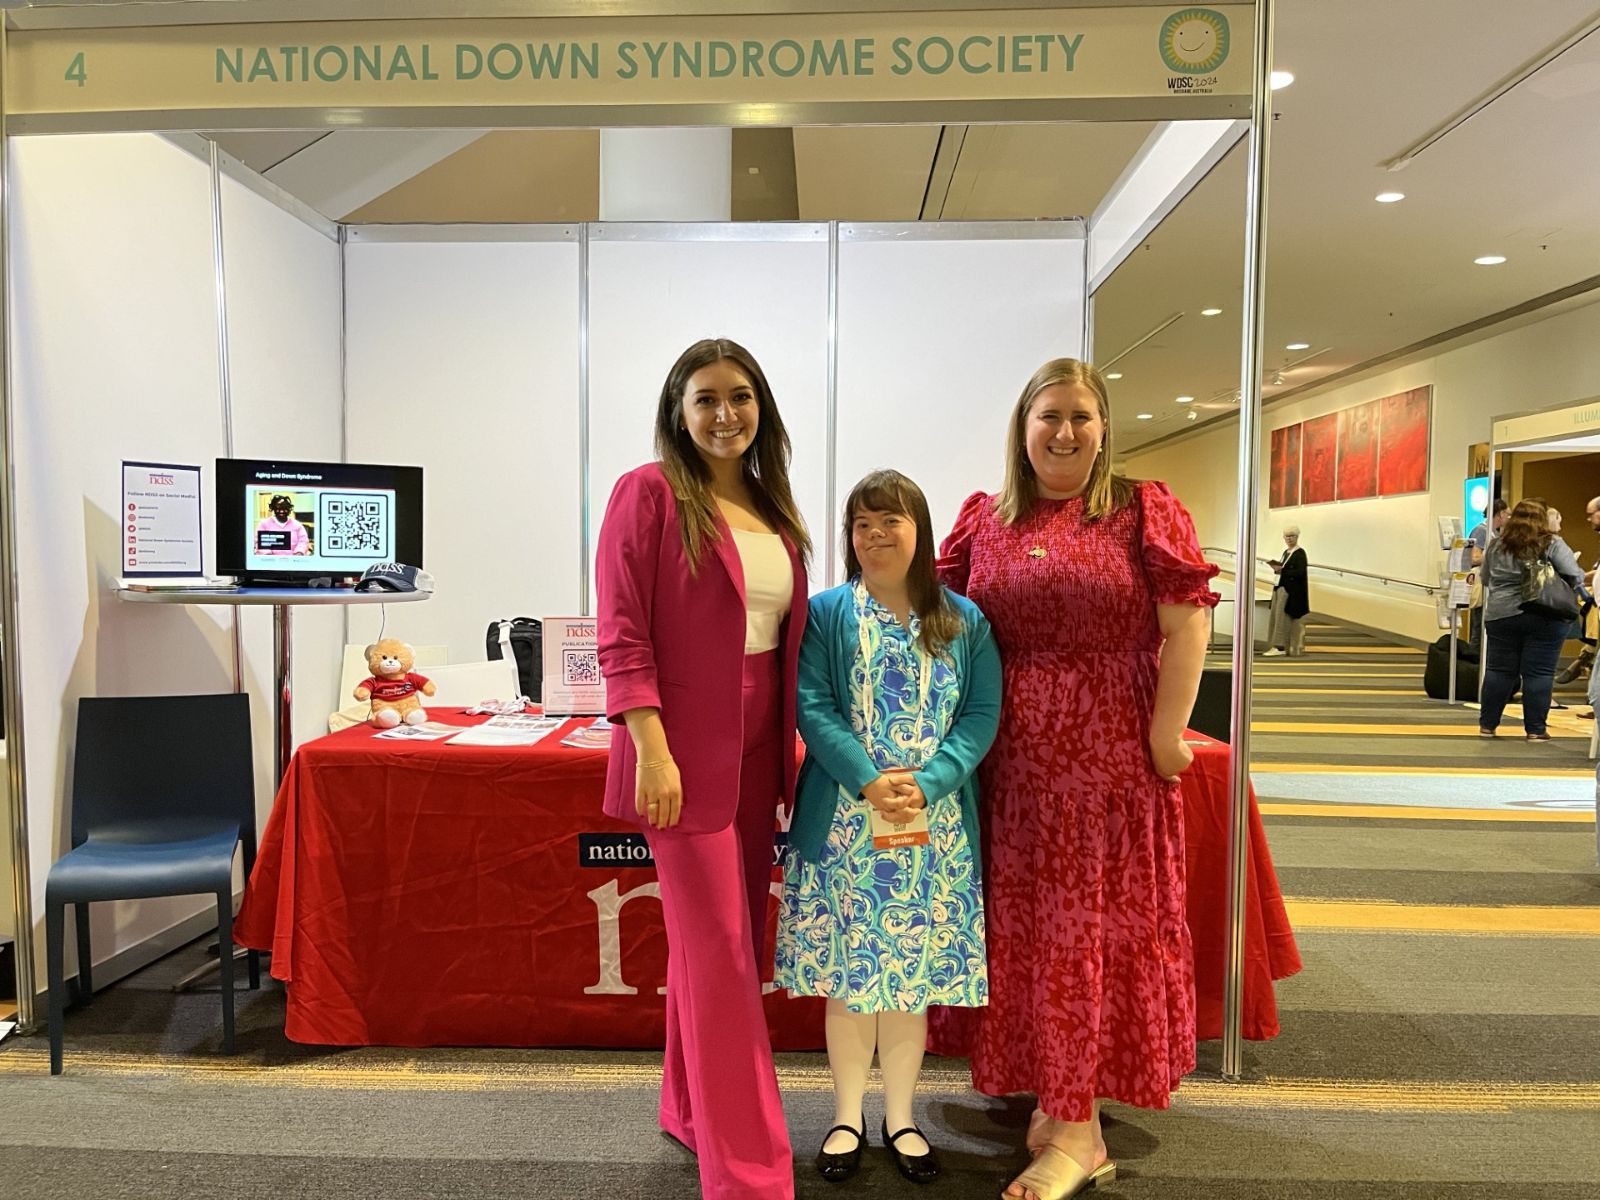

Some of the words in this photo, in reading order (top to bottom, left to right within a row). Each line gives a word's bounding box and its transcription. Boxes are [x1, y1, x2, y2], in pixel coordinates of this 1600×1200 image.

[215, 44, 439, 83] NATIONAL
[455, 41, 600, 80] DOWN
[616, 38, 875, 79] SYNDROME
[891, 34, 1085, 75] SOCIETY
[65, 53, 87, 87] 4
[1167, 76, 1193, 89] WDSC
[1194, 76, 1218, 88] 2024
[149, 472, 174, 485] ndss
[566, 623, 596, 638] ndss
[888, 836, 916, 846] Speaker
